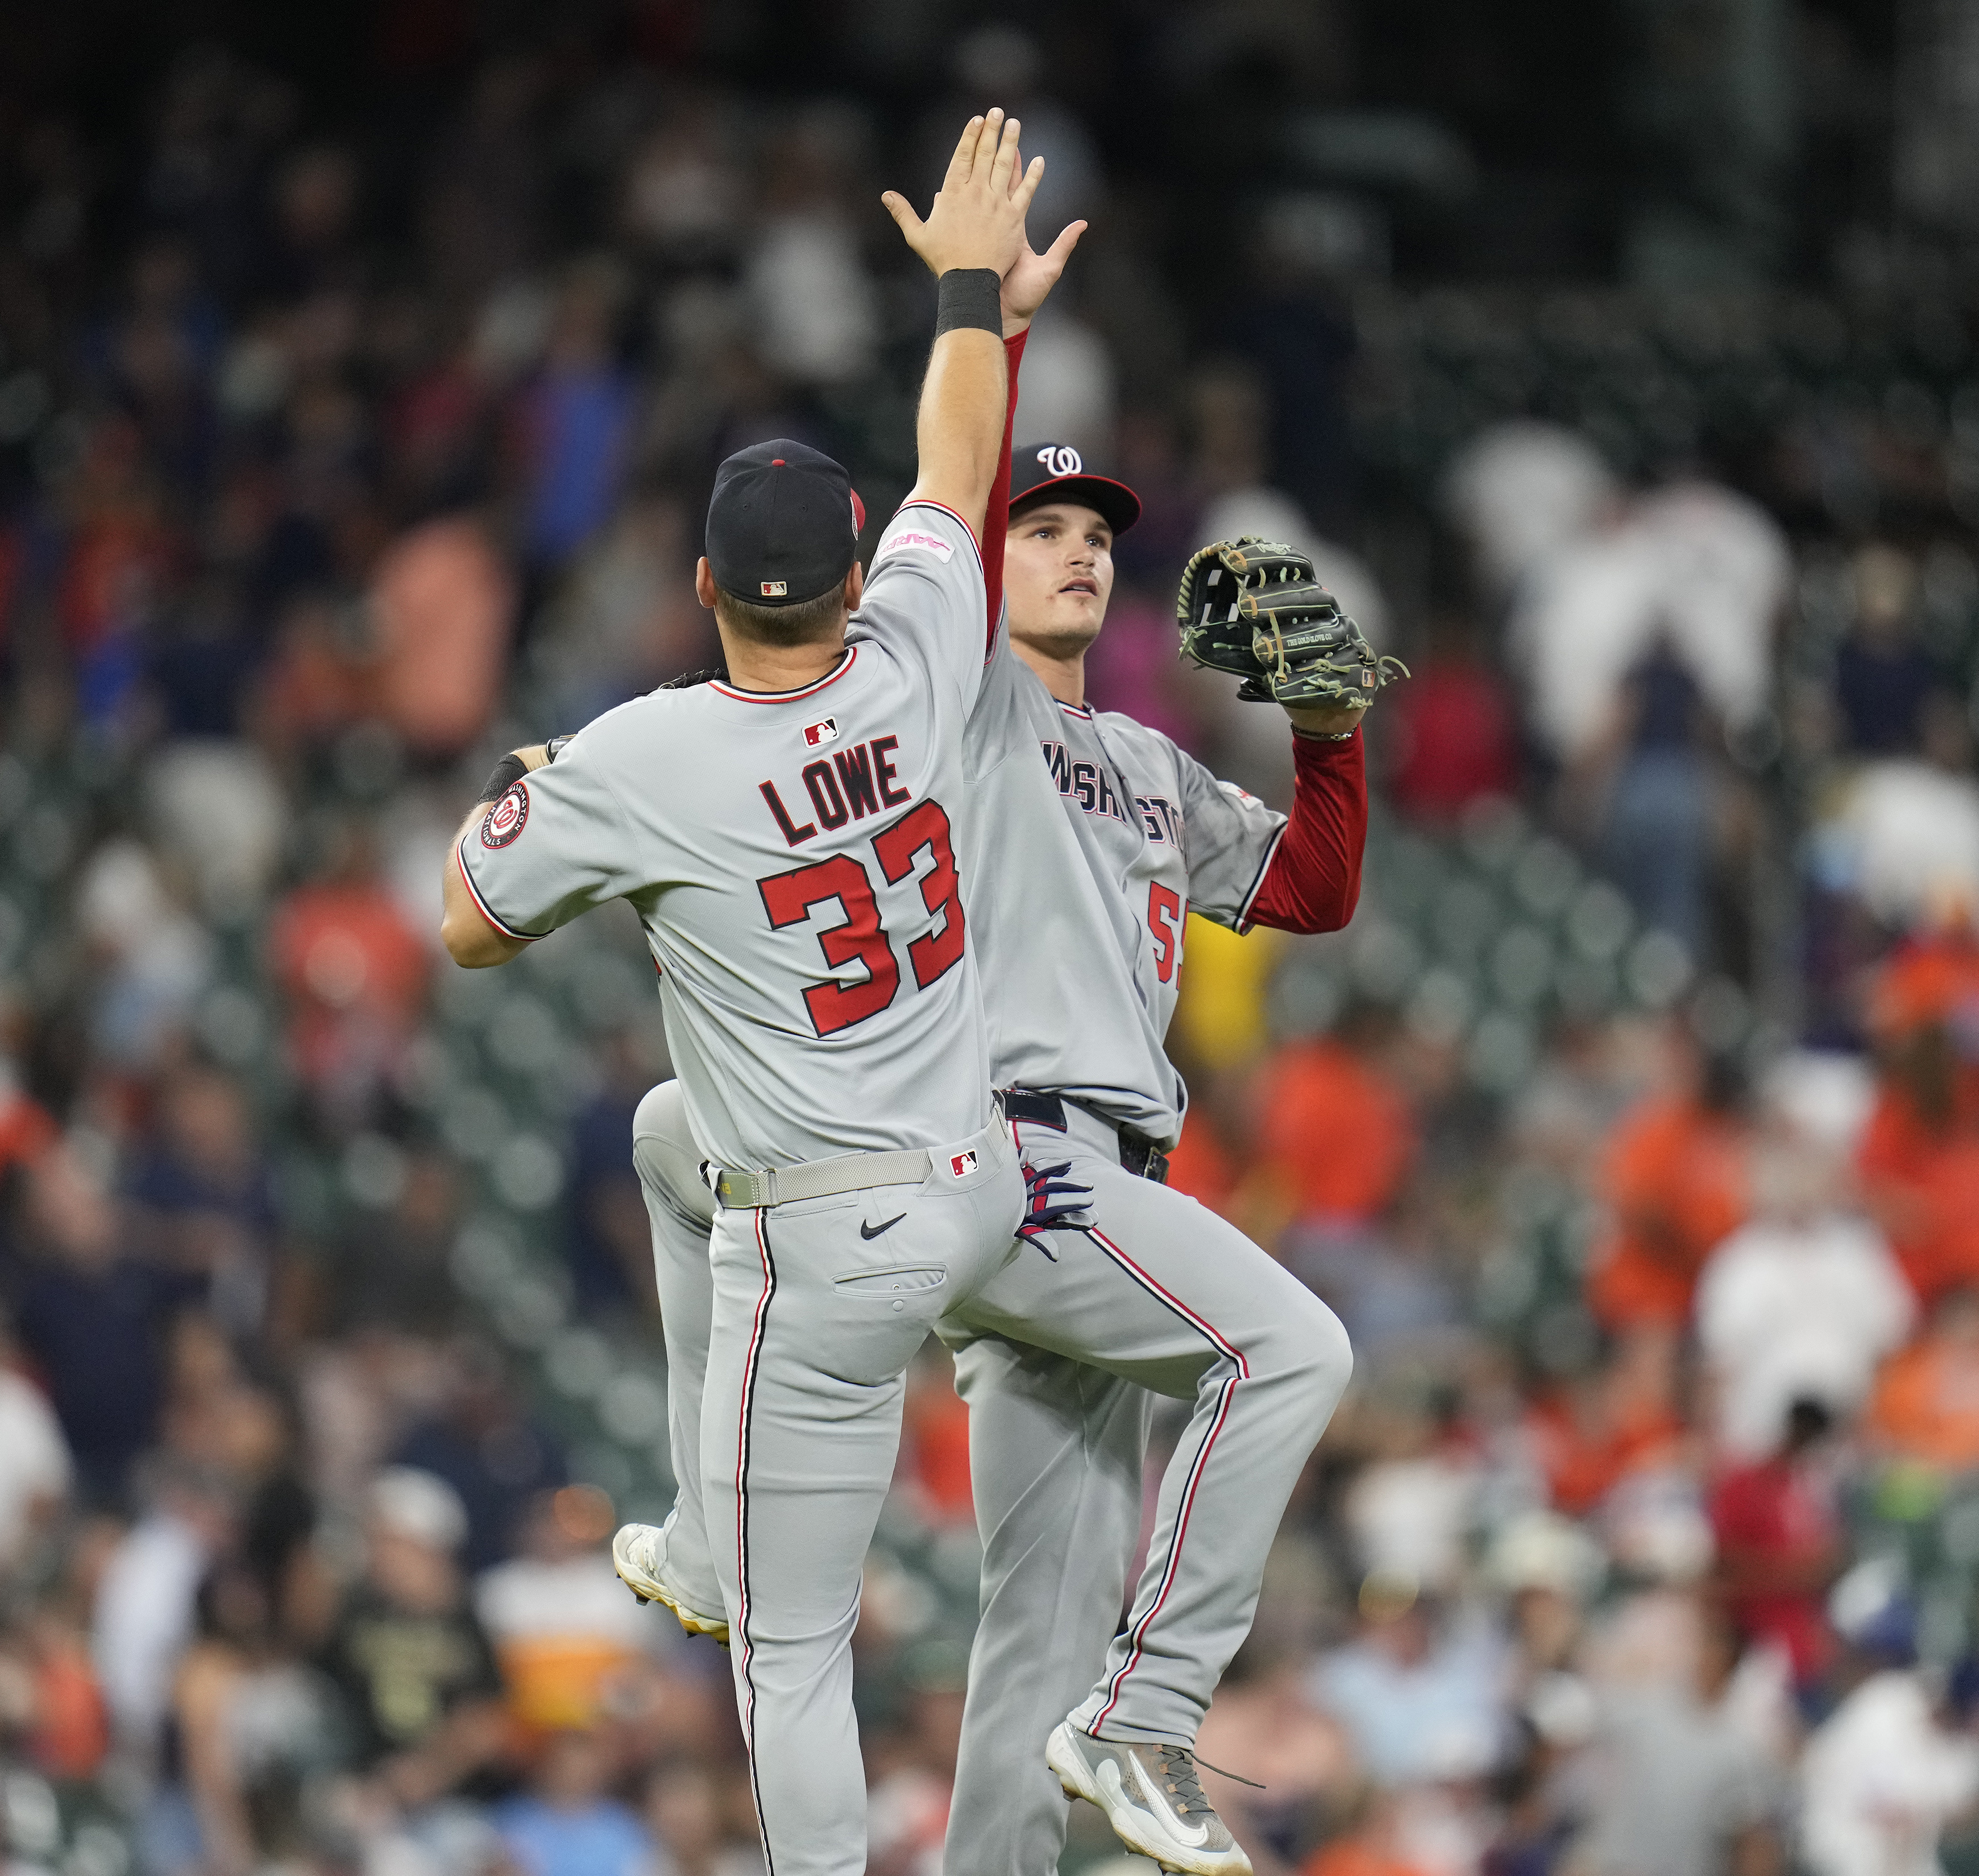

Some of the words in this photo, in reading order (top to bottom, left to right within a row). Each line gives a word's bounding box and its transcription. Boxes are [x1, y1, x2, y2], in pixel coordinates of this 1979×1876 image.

[1036, 446, 1082, 476] W
[882, 533, 951, 552] AARP
[1287, 638, 1297, 647] THE
[1310, 634, 1325, 643] GLOVE
[508, 783, 527, 831] WASHINGTON
[758, 734, 912, 848] LOWE
[483, 806, 501, 846] NATIONALS
[756, 797, 965, 1039] 33
[1147, 880, 1189, 991] 5
